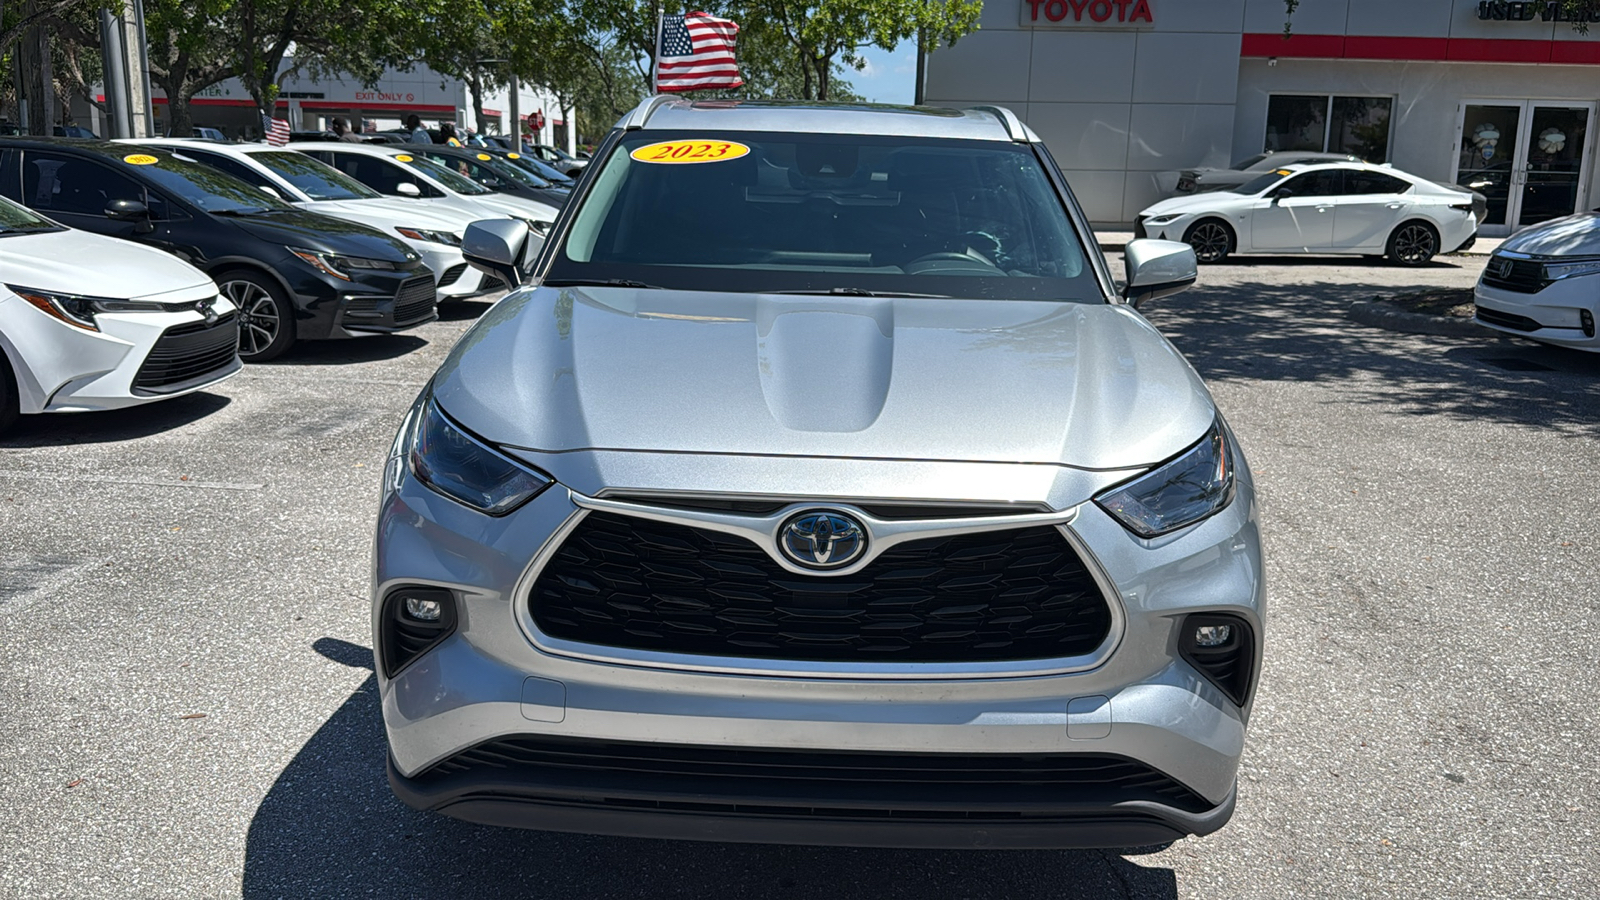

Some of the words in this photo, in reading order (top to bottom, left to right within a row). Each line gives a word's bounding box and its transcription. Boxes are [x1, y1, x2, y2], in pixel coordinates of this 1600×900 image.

[1026, 0, 1153, 23] TOYOTA
[1478, 1, 1538, 21] USED
[355, 92, 375, 100] EXIT
[377, 93, 403, 101] ONLY
[649, 144, 731, 160] 2023
